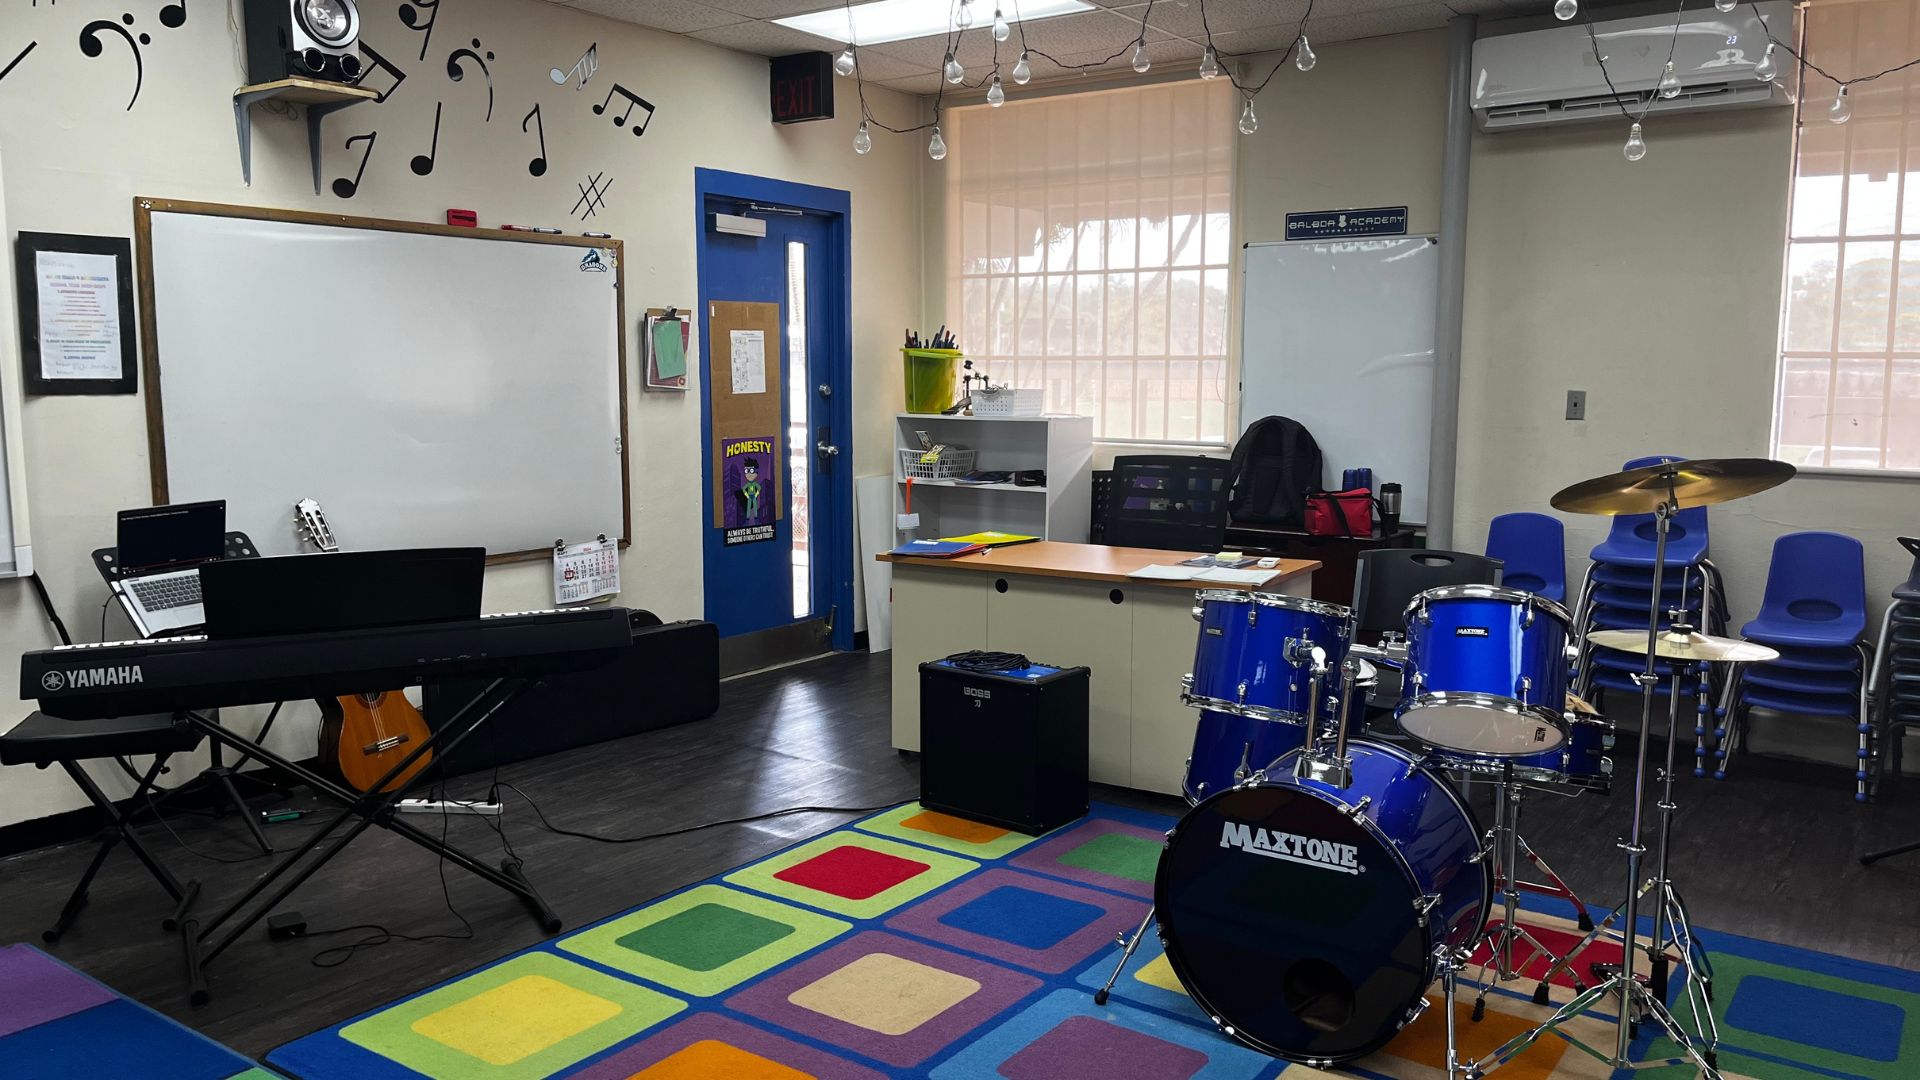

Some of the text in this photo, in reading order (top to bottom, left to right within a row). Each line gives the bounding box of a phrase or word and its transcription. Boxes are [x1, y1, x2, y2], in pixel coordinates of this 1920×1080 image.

[1726, 35, 1737, 45] 23
[775, 75, 816, 117] EXIT
[1288, 215, 1405, 230] BALBOA ACADEMY
[726, 441, 772, 457] HONESTY
[728, 528, 746, 537] ALWAYS
[66, 665, 143, 689] YAMAHA
[964, 686, 990, 698] BOSS
[1219, 821, 1358, 868] MAXTONE
